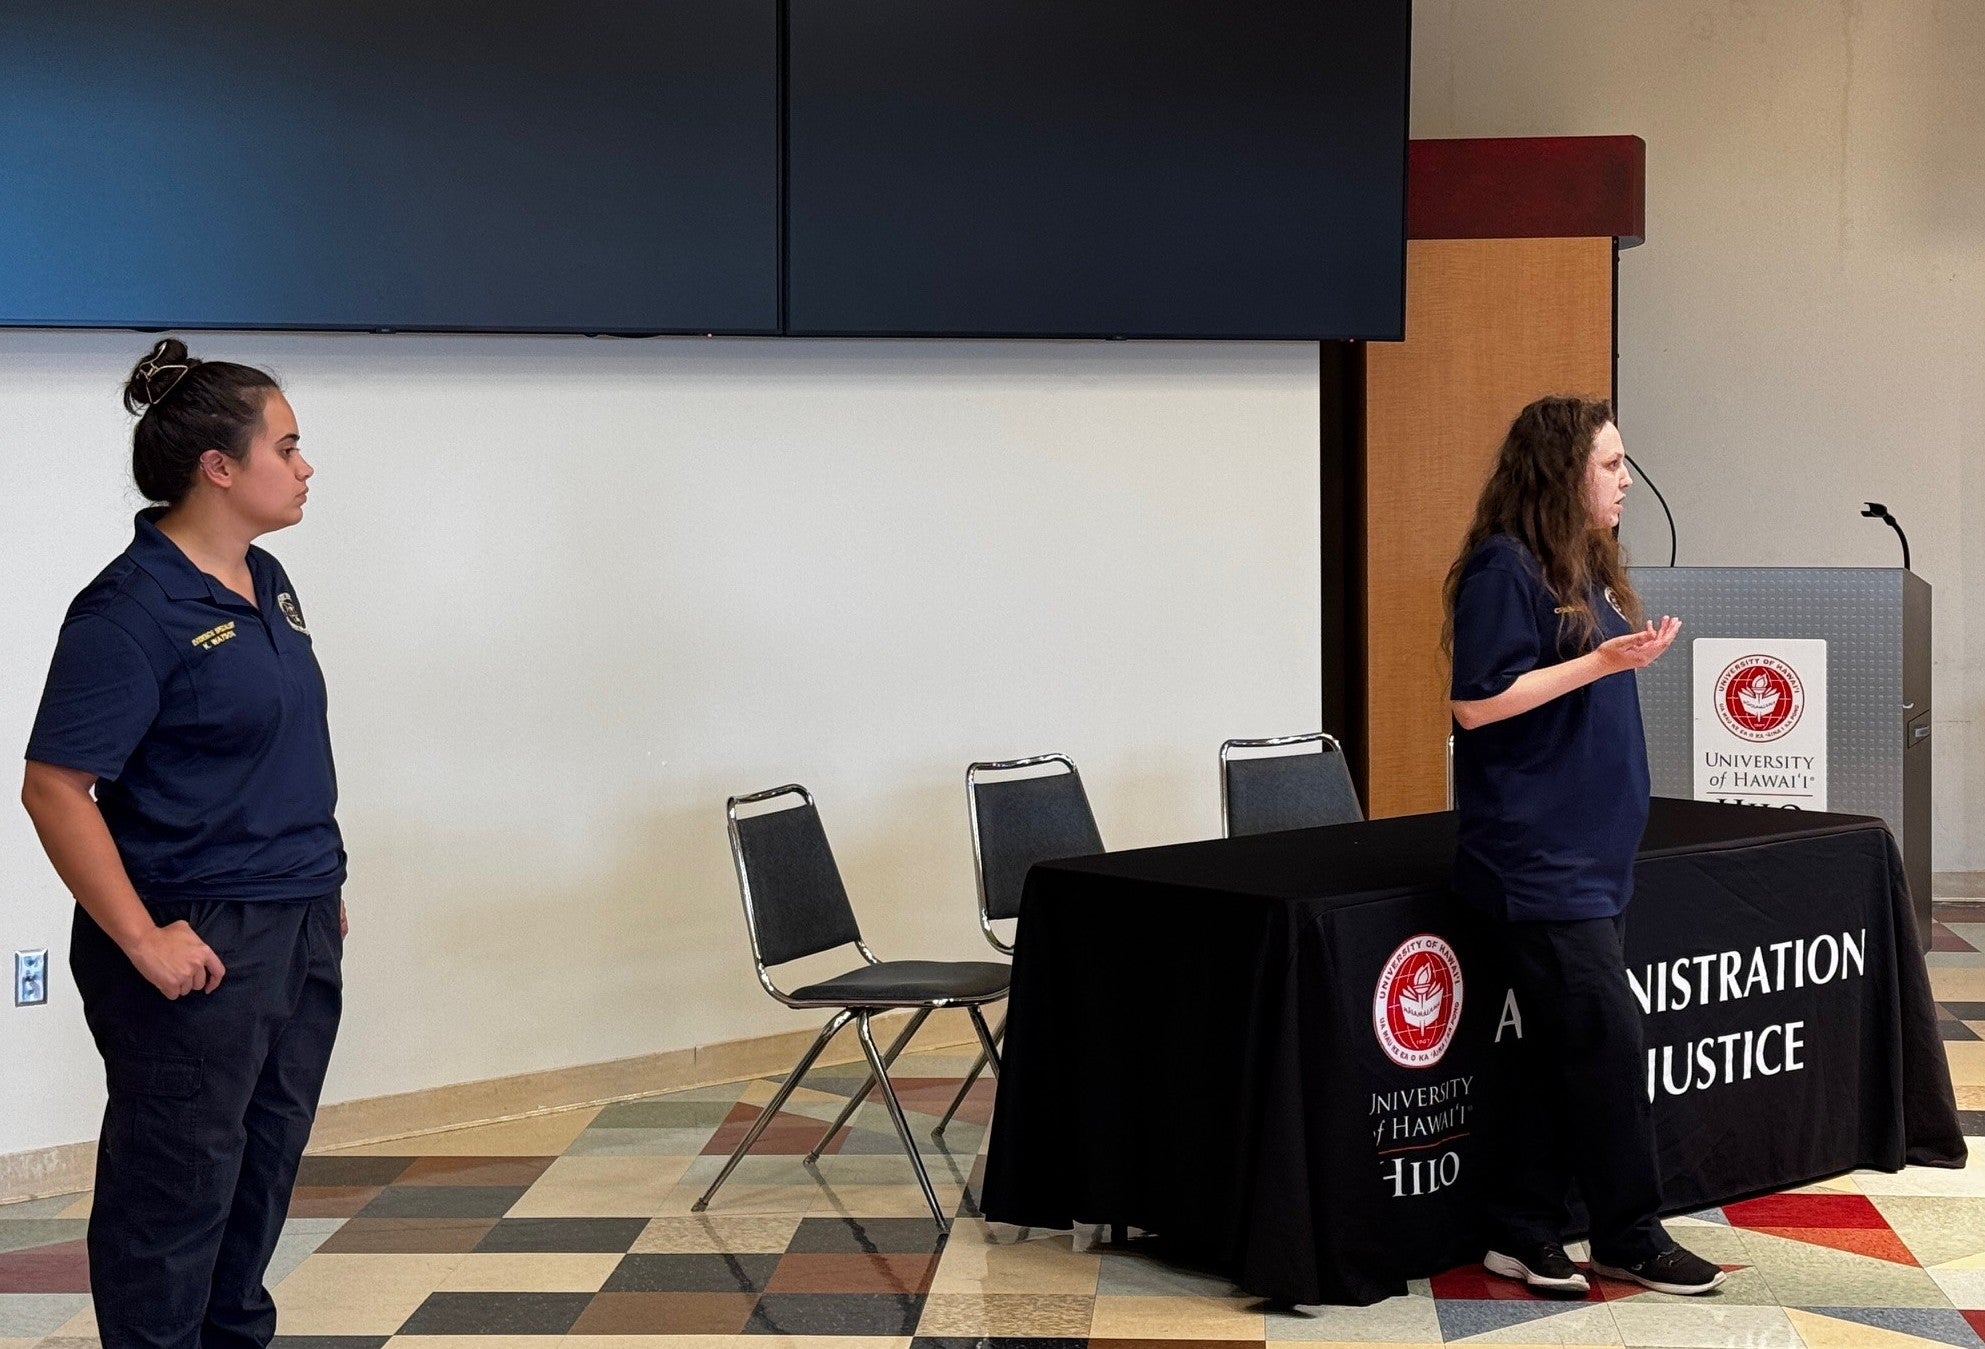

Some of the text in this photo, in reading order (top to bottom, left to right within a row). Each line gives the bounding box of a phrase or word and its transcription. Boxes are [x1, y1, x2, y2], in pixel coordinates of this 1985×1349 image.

[1719, 658, 1760, 692] UNIVERSITY
[1705, 752, 1815, 770] UNIVERSITY
[1709, 771, 1728, 789] of
[1379, 941, 1422, 999] UNIVERSITY
[1425, 940, 1439, 949] OF
[1647, 1020, 1805, 1104] JUSTICE
